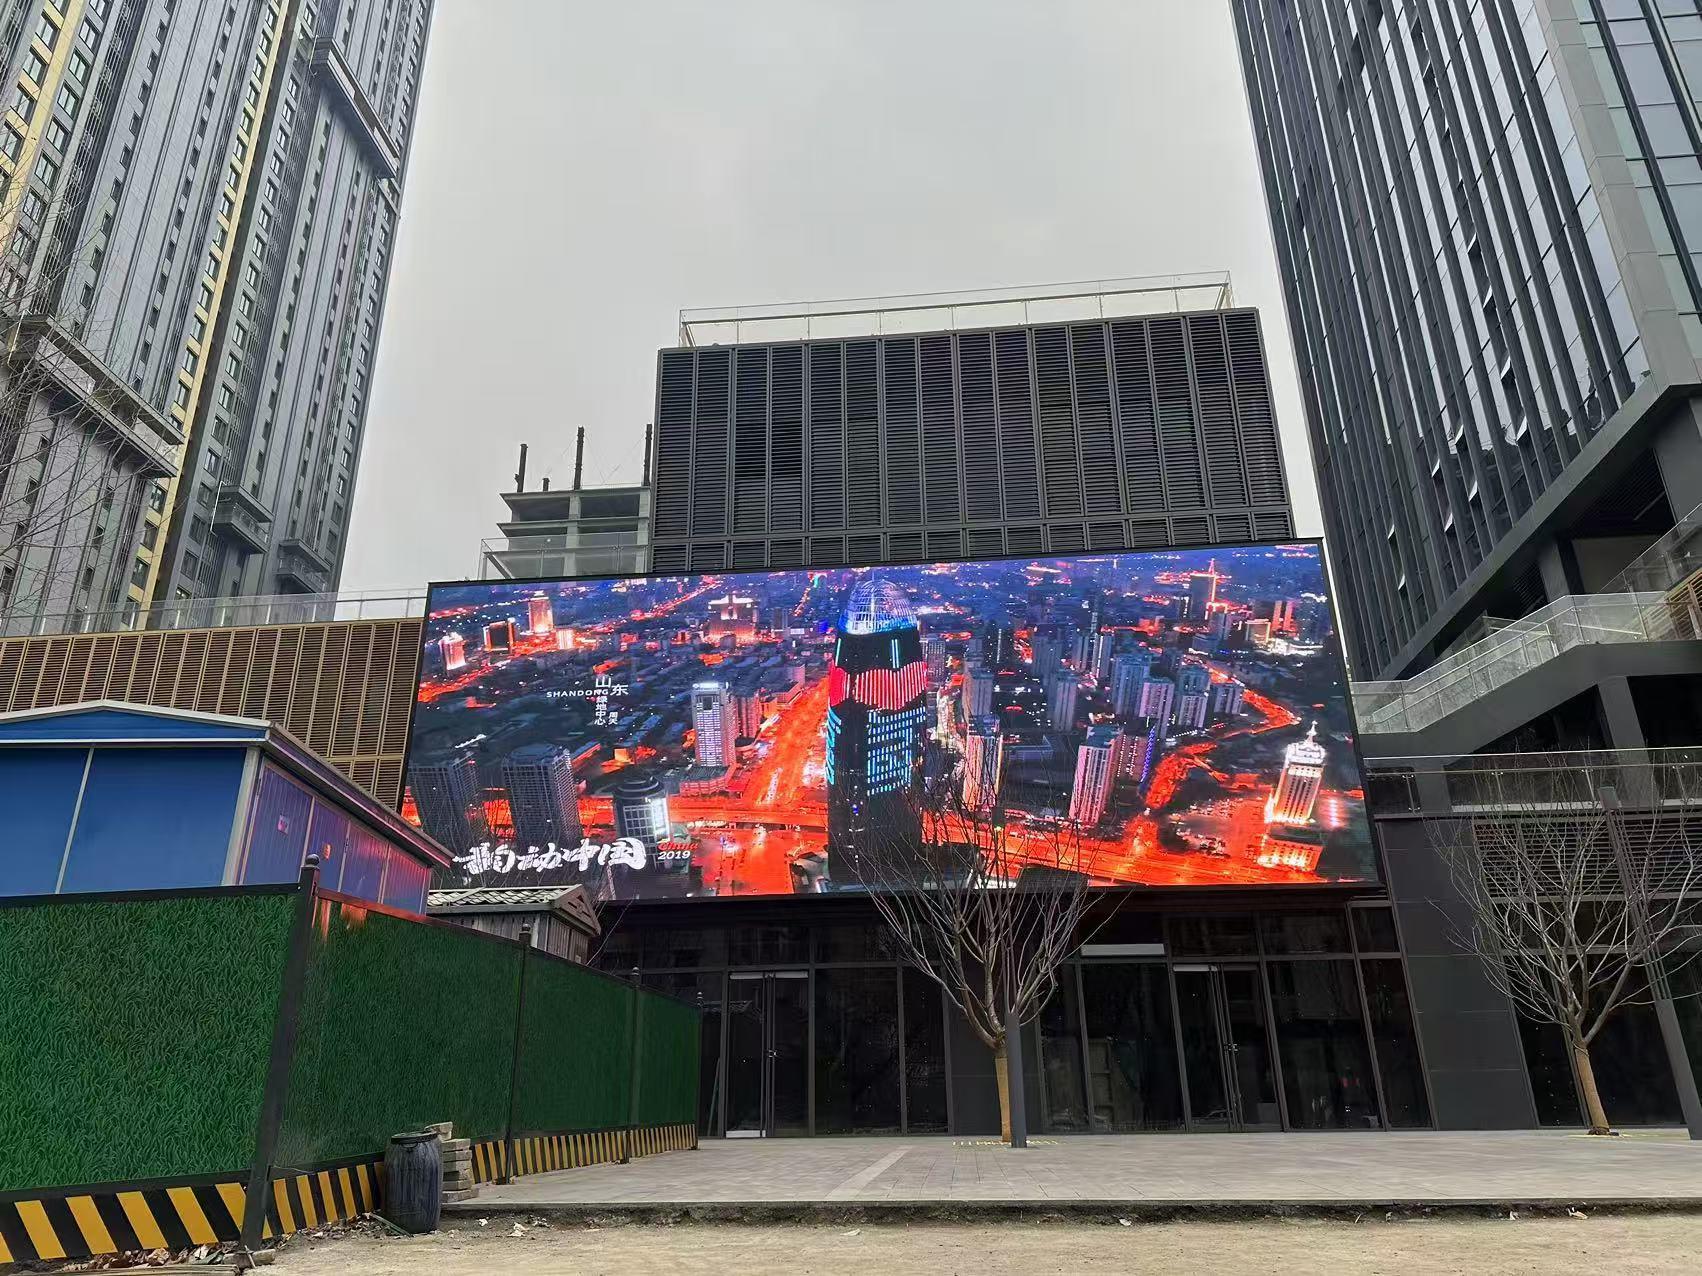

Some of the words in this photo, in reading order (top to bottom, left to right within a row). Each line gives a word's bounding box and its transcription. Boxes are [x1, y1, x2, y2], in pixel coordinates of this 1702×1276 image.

[595, 676, 629, 696] 山东
[546, 689, 609, 698] SHANDONG
[657, 850, 691, 860] 2019
